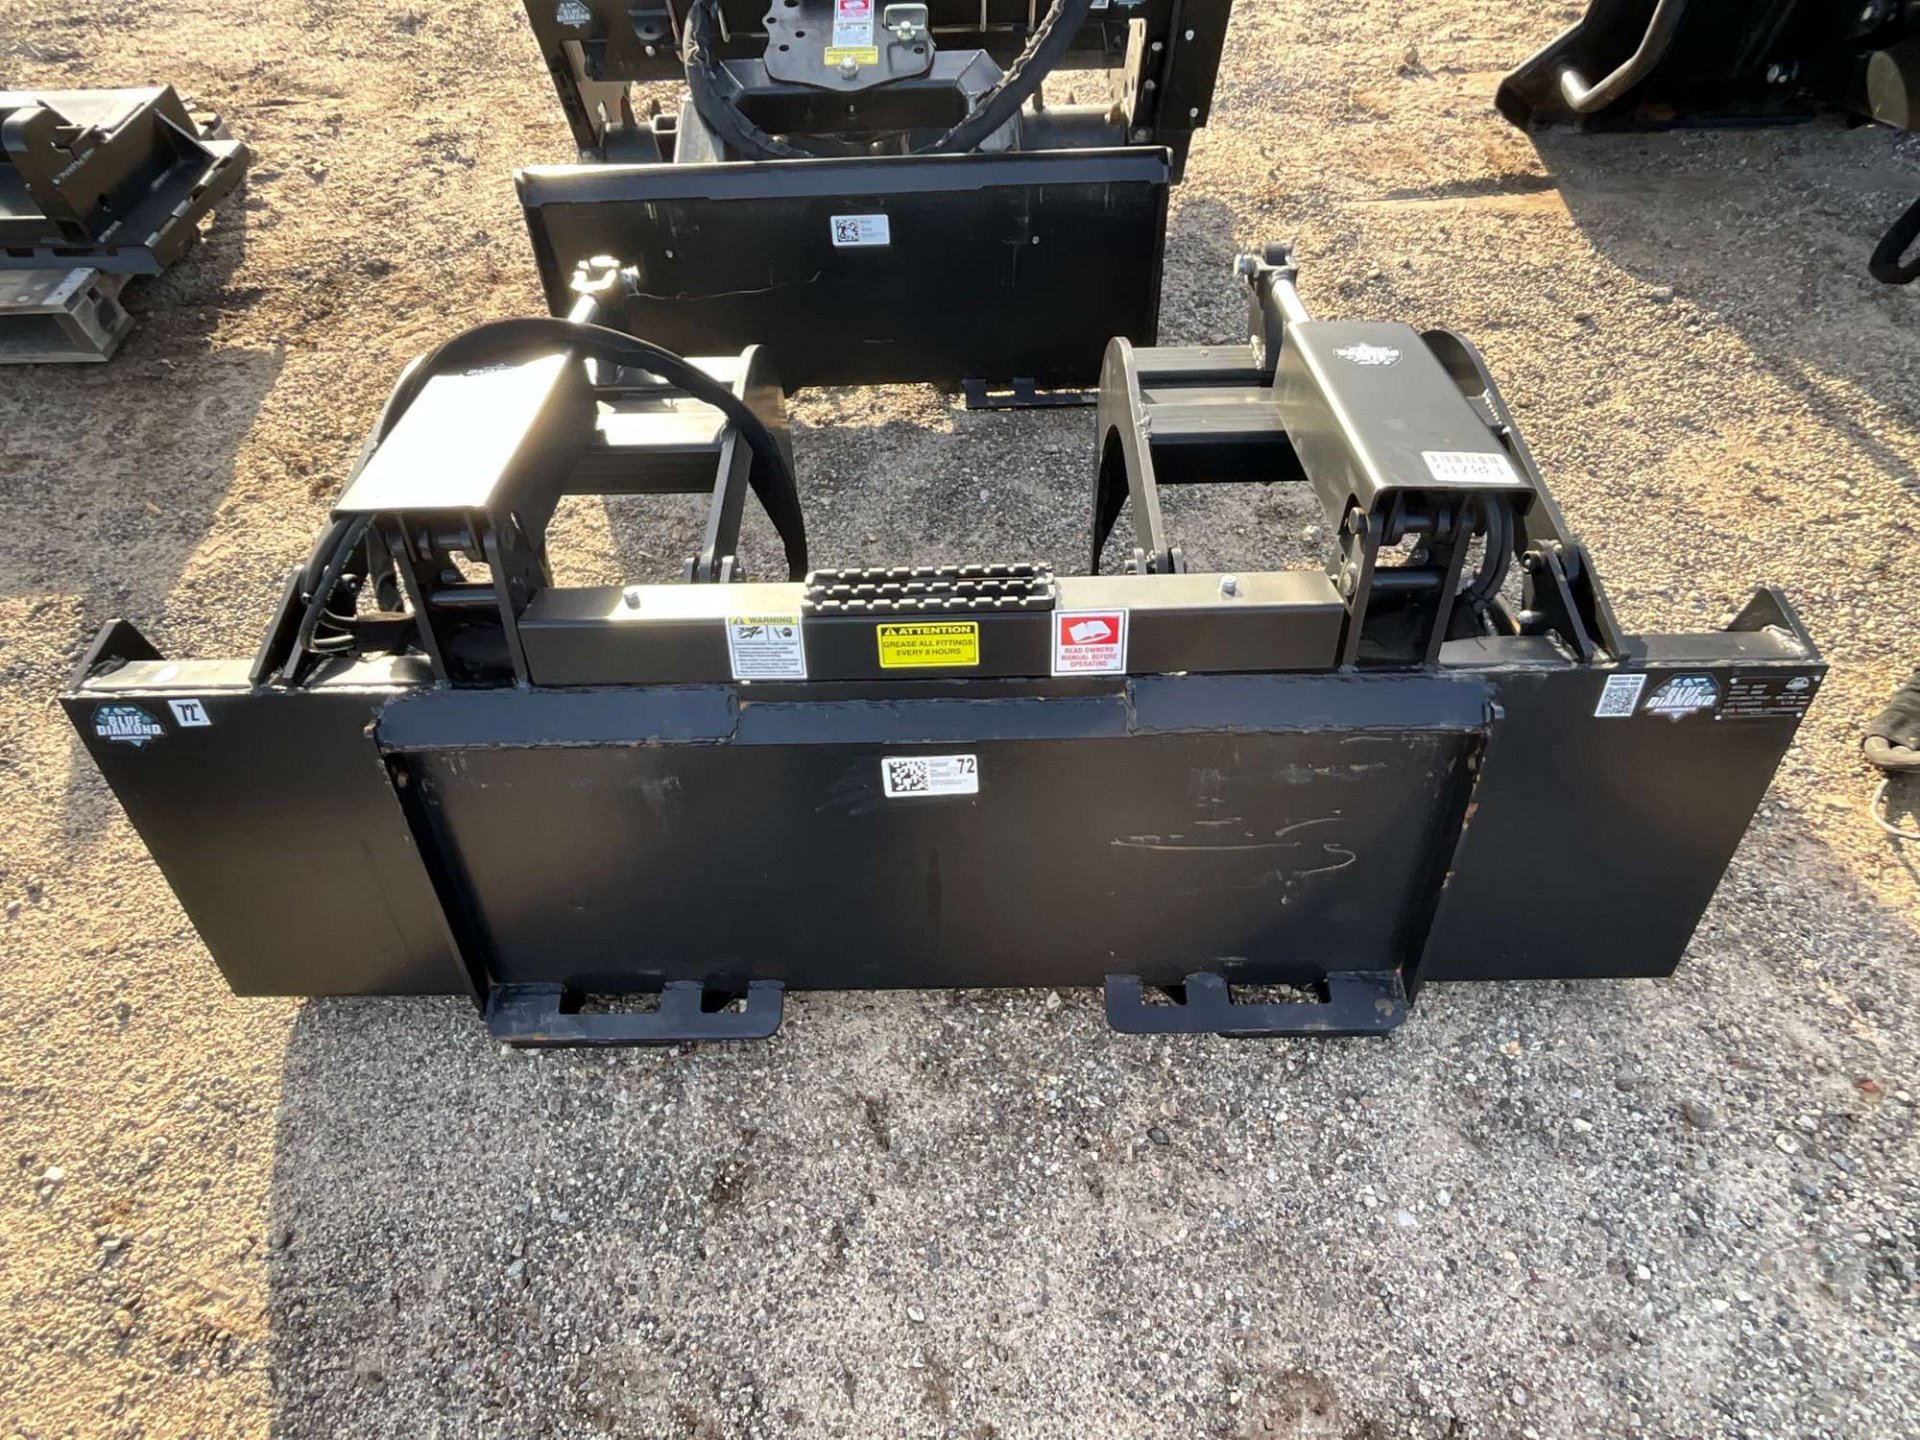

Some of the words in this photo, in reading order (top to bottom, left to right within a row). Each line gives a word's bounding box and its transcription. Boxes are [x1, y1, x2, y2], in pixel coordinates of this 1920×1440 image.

[750, 616, 793, 624] WARNING
[899, 626, 971, 635] ATTENTION
[883, 640, 917, 649] GREASE
[918, 640, 935, 648] ALL
[936, 638, 974, 647] FITTINGS
[932, 647, 961, 655] HOURS
[1664, 686, 1705, 697] BLUE
[1646, 695, 1717, 707] DIAMOND
[107, 715, 142, 726] BLUE
[95, 723, 163, 736] DIAMOND
[956, 757, 976, 774] 72
